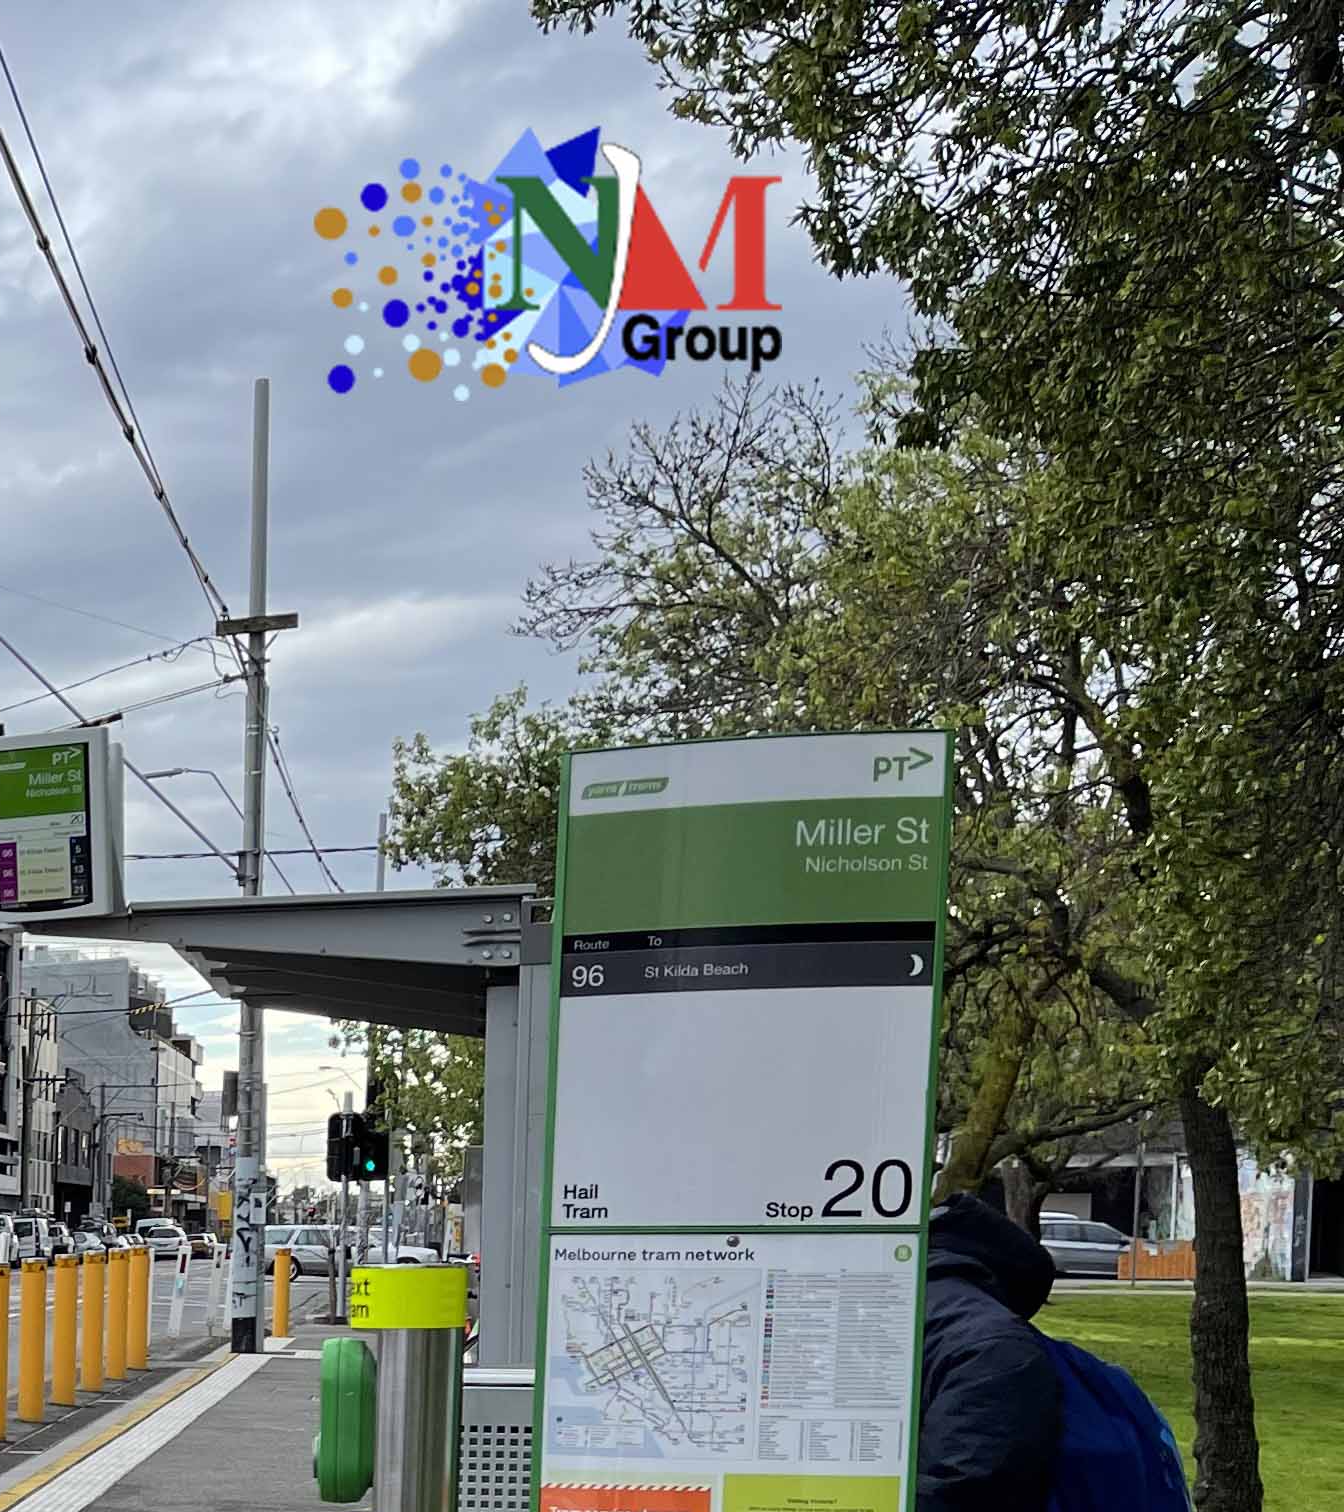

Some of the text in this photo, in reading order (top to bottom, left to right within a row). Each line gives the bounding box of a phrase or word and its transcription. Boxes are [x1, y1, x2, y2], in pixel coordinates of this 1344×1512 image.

[28, 773, 62, 786] Miller
[796, 816, 930, 848] Miller St
[805, 853, 928, 873] Nicholson St
[574, 935, 662, 951] Route To
[571, 962, 749, 988] 96 St Kilda Beach
[562, 1159, 913, 1221] Tram Stop 20
[563, 1184, 599, 1200] Hail
[554, 1248, 755, 1262] Melbourne tram network
